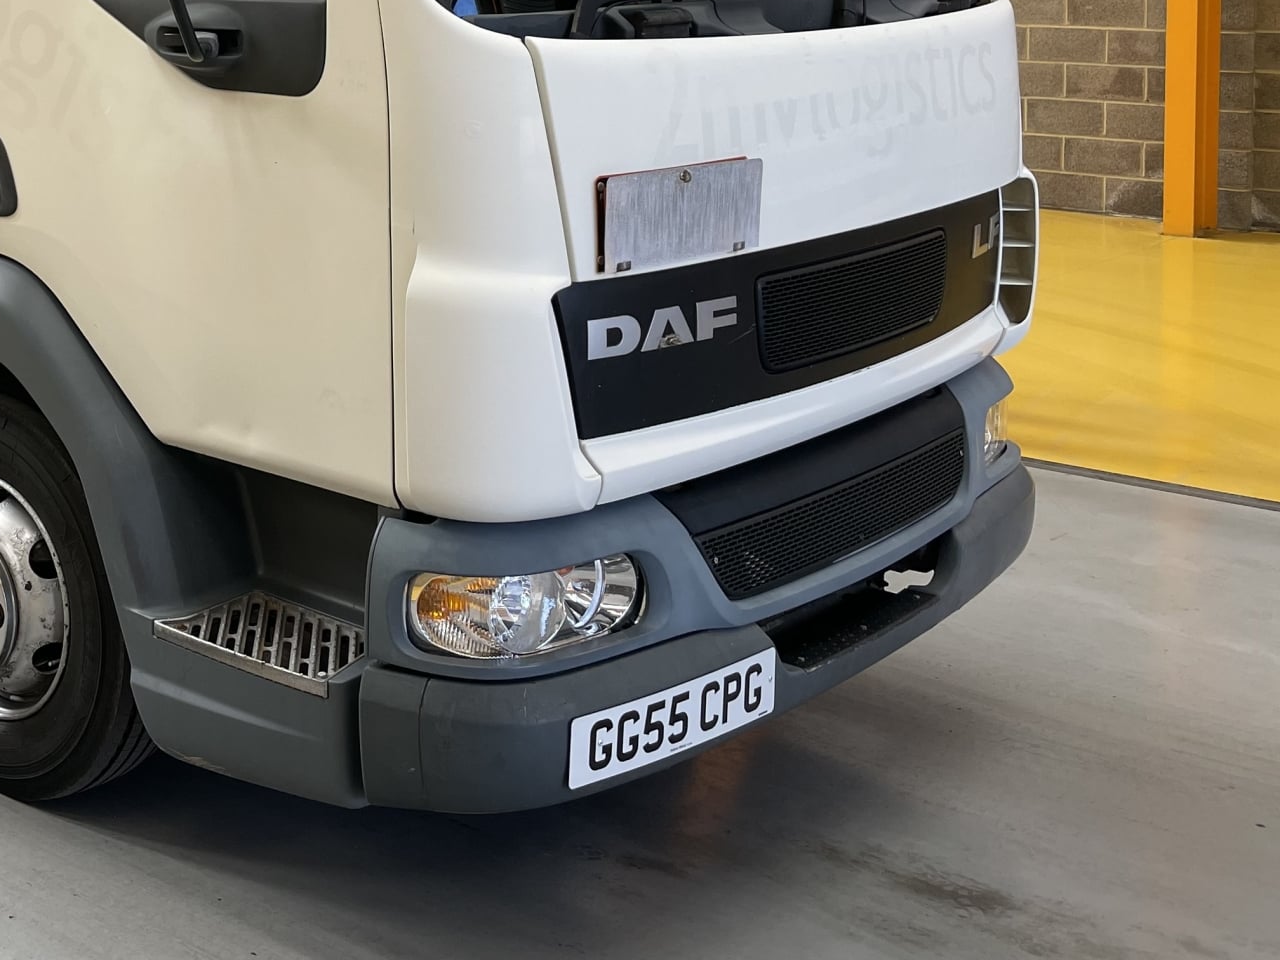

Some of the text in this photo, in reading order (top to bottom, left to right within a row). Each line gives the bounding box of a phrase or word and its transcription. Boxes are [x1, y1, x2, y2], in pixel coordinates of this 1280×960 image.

[587, 295, 738, 361] DAF
[588, 662, 762, 772] GG55 CPG
